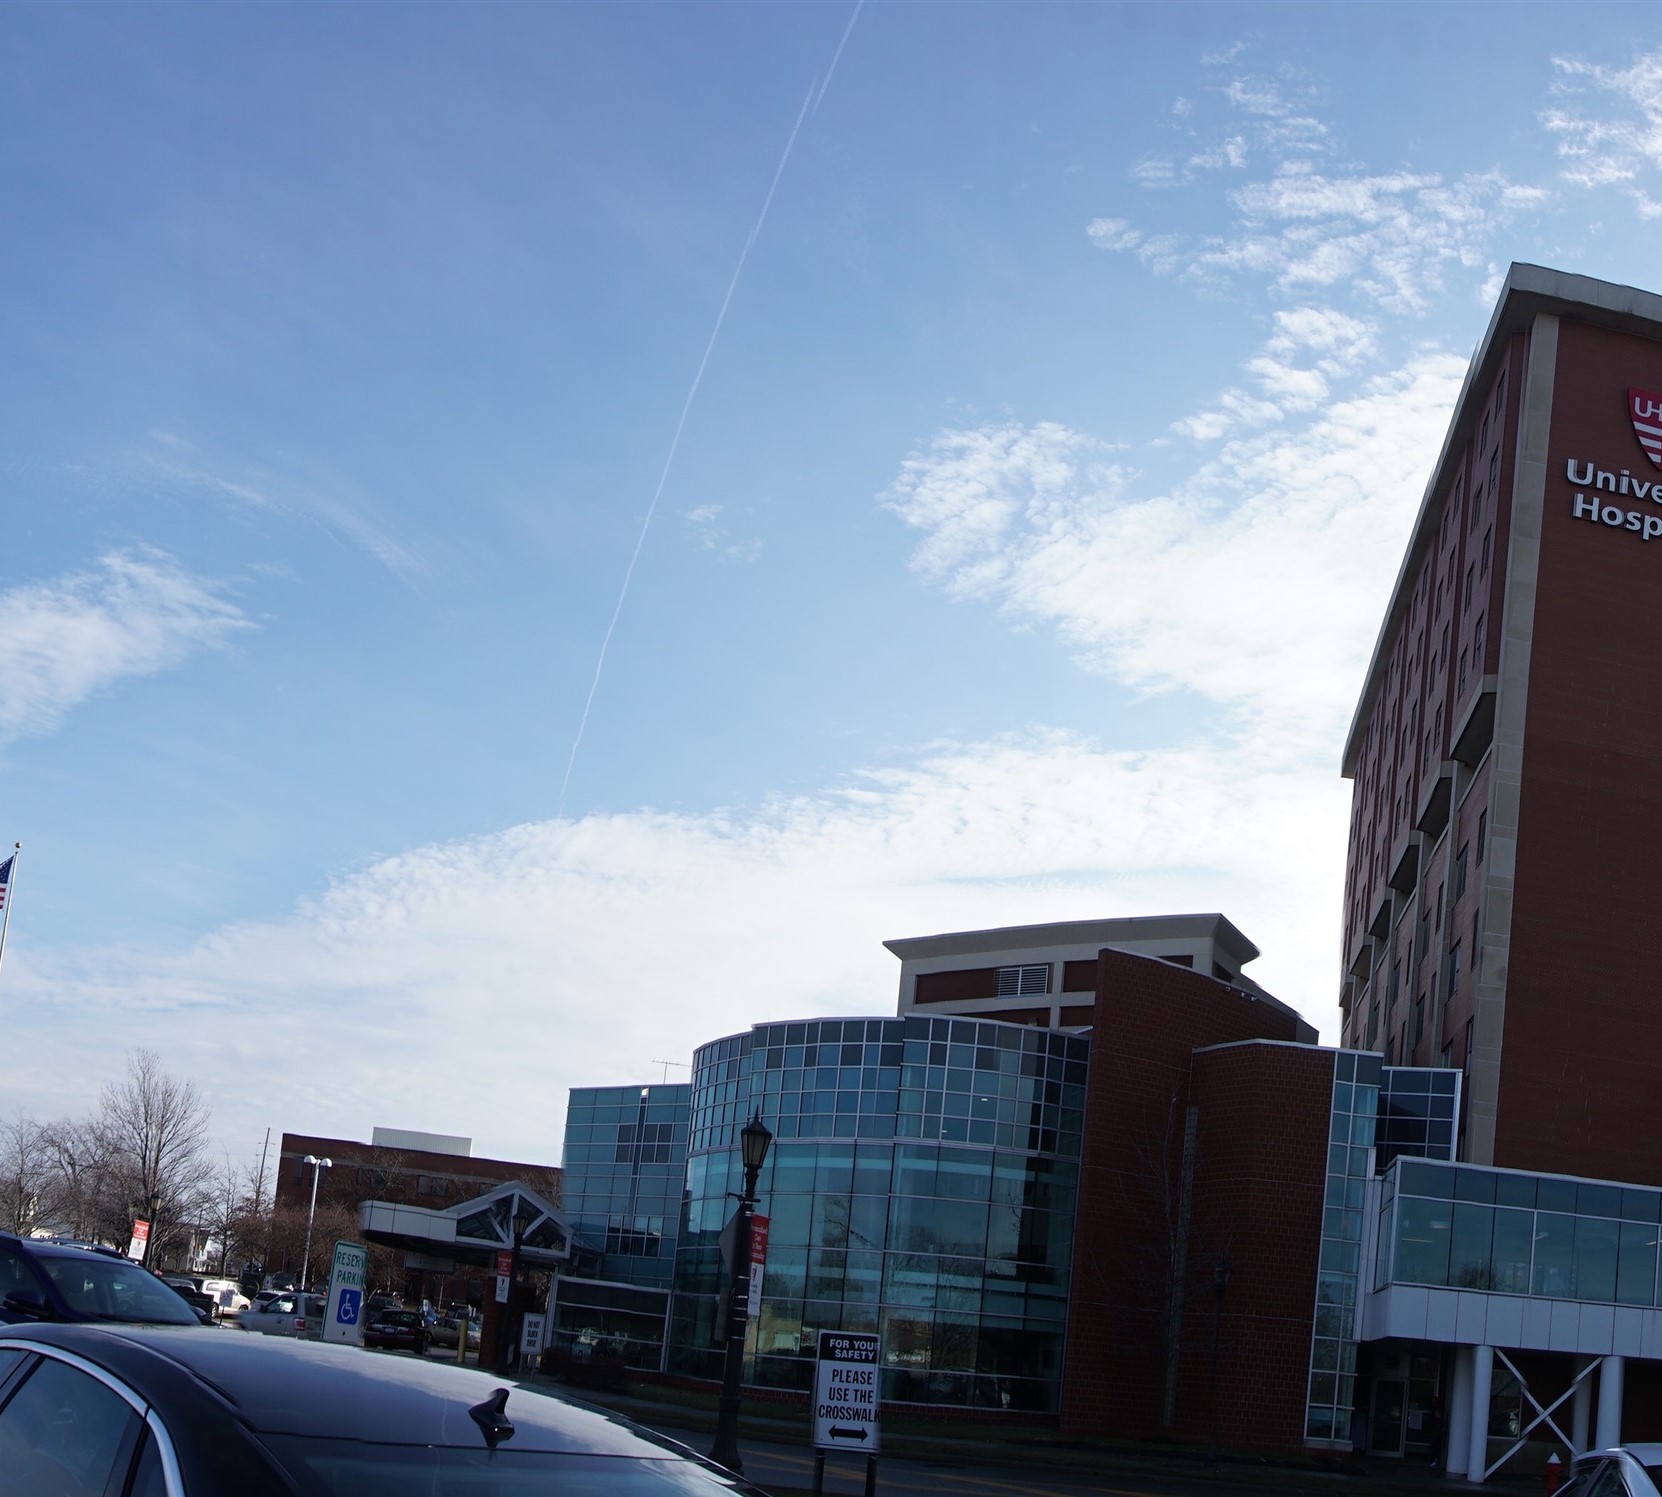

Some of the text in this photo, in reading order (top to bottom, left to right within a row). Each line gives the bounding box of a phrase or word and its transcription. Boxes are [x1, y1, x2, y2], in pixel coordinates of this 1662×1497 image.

[829, 1339, 880, 1351] FOR YOUR
[834, 1349, 875, 1360] SAFETY
[831, 1368, 874, 1385] PLEASE
[828, 1386, 874, 1404] USE THE
[818, 1404, 881, 1423] CROSSWALK
